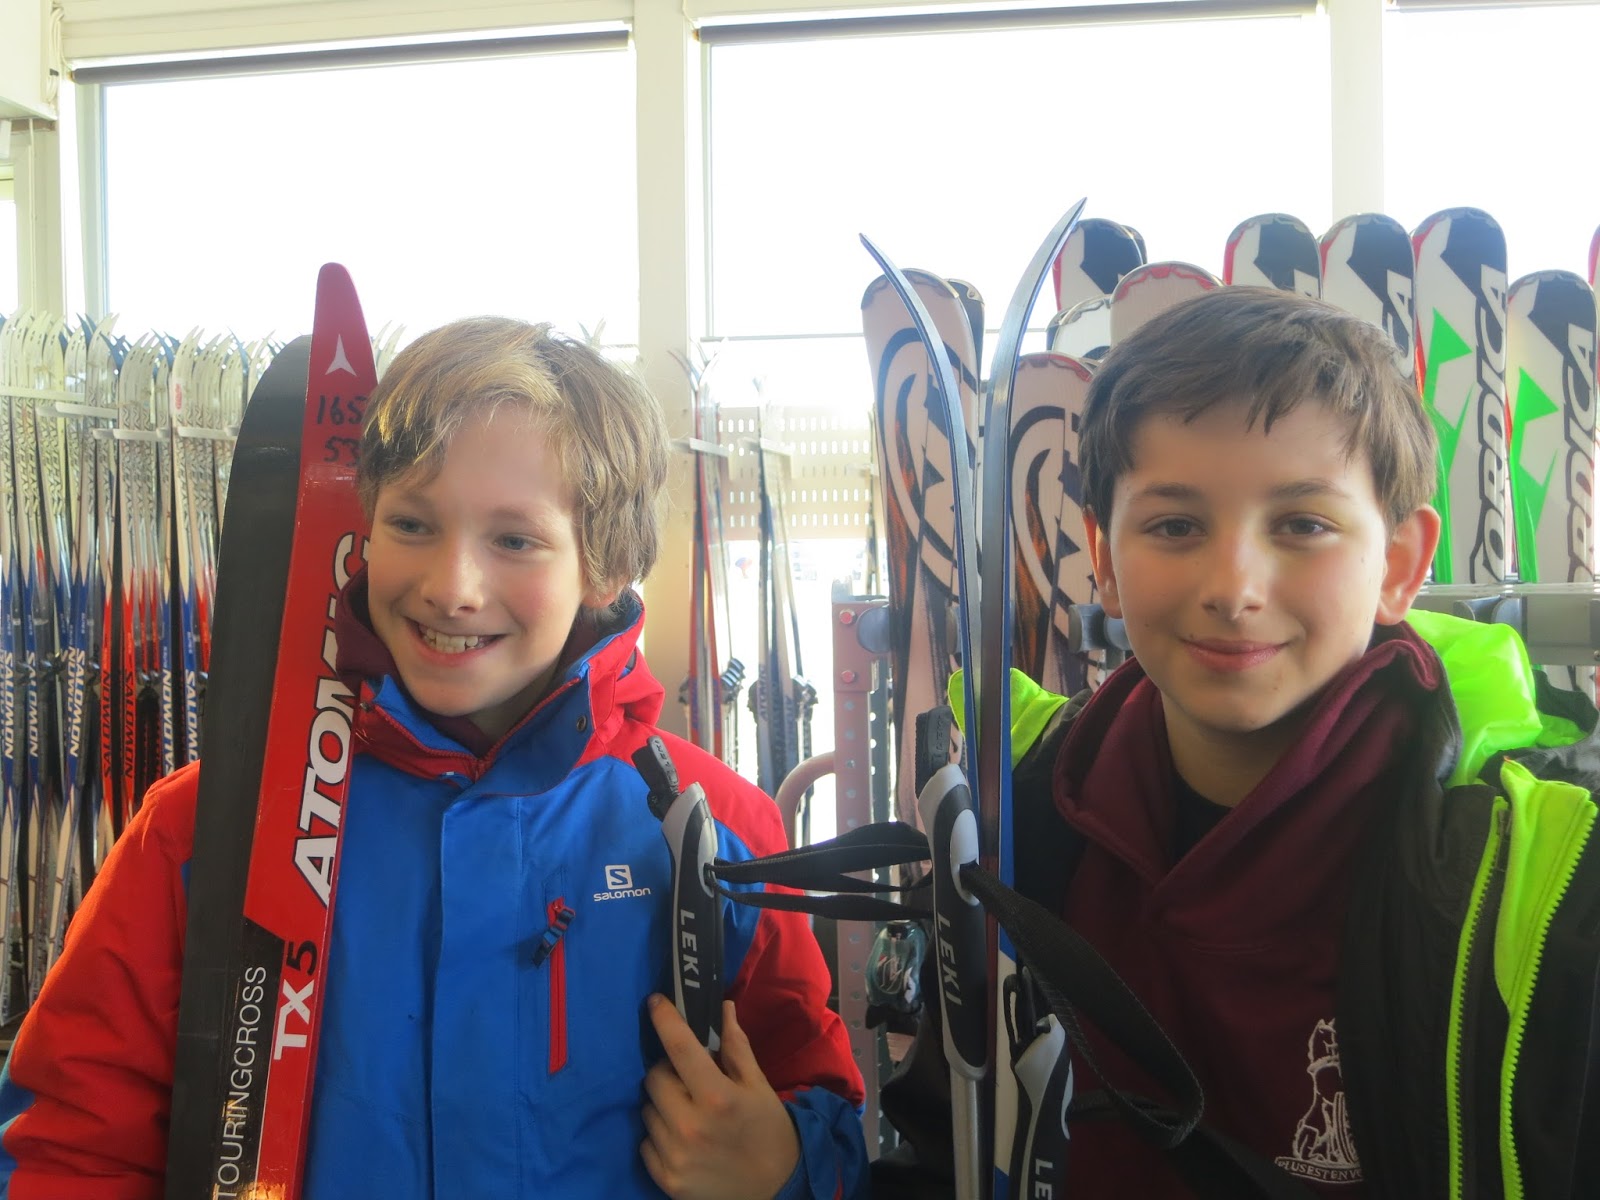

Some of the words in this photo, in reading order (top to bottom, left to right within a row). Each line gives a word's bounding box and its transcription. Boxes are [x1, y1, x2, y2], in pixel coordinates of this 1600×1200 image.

[1472, 264, 1505, 583] ORDICA
[70, 648, 85, 757] SALOMON
[125, 671, 135, 778] SALOMON
[186, 669, 198, 762] SALOMO
[680, 908, 700, 989] LEKI
[937, 912, 962, 1006] LEKI
